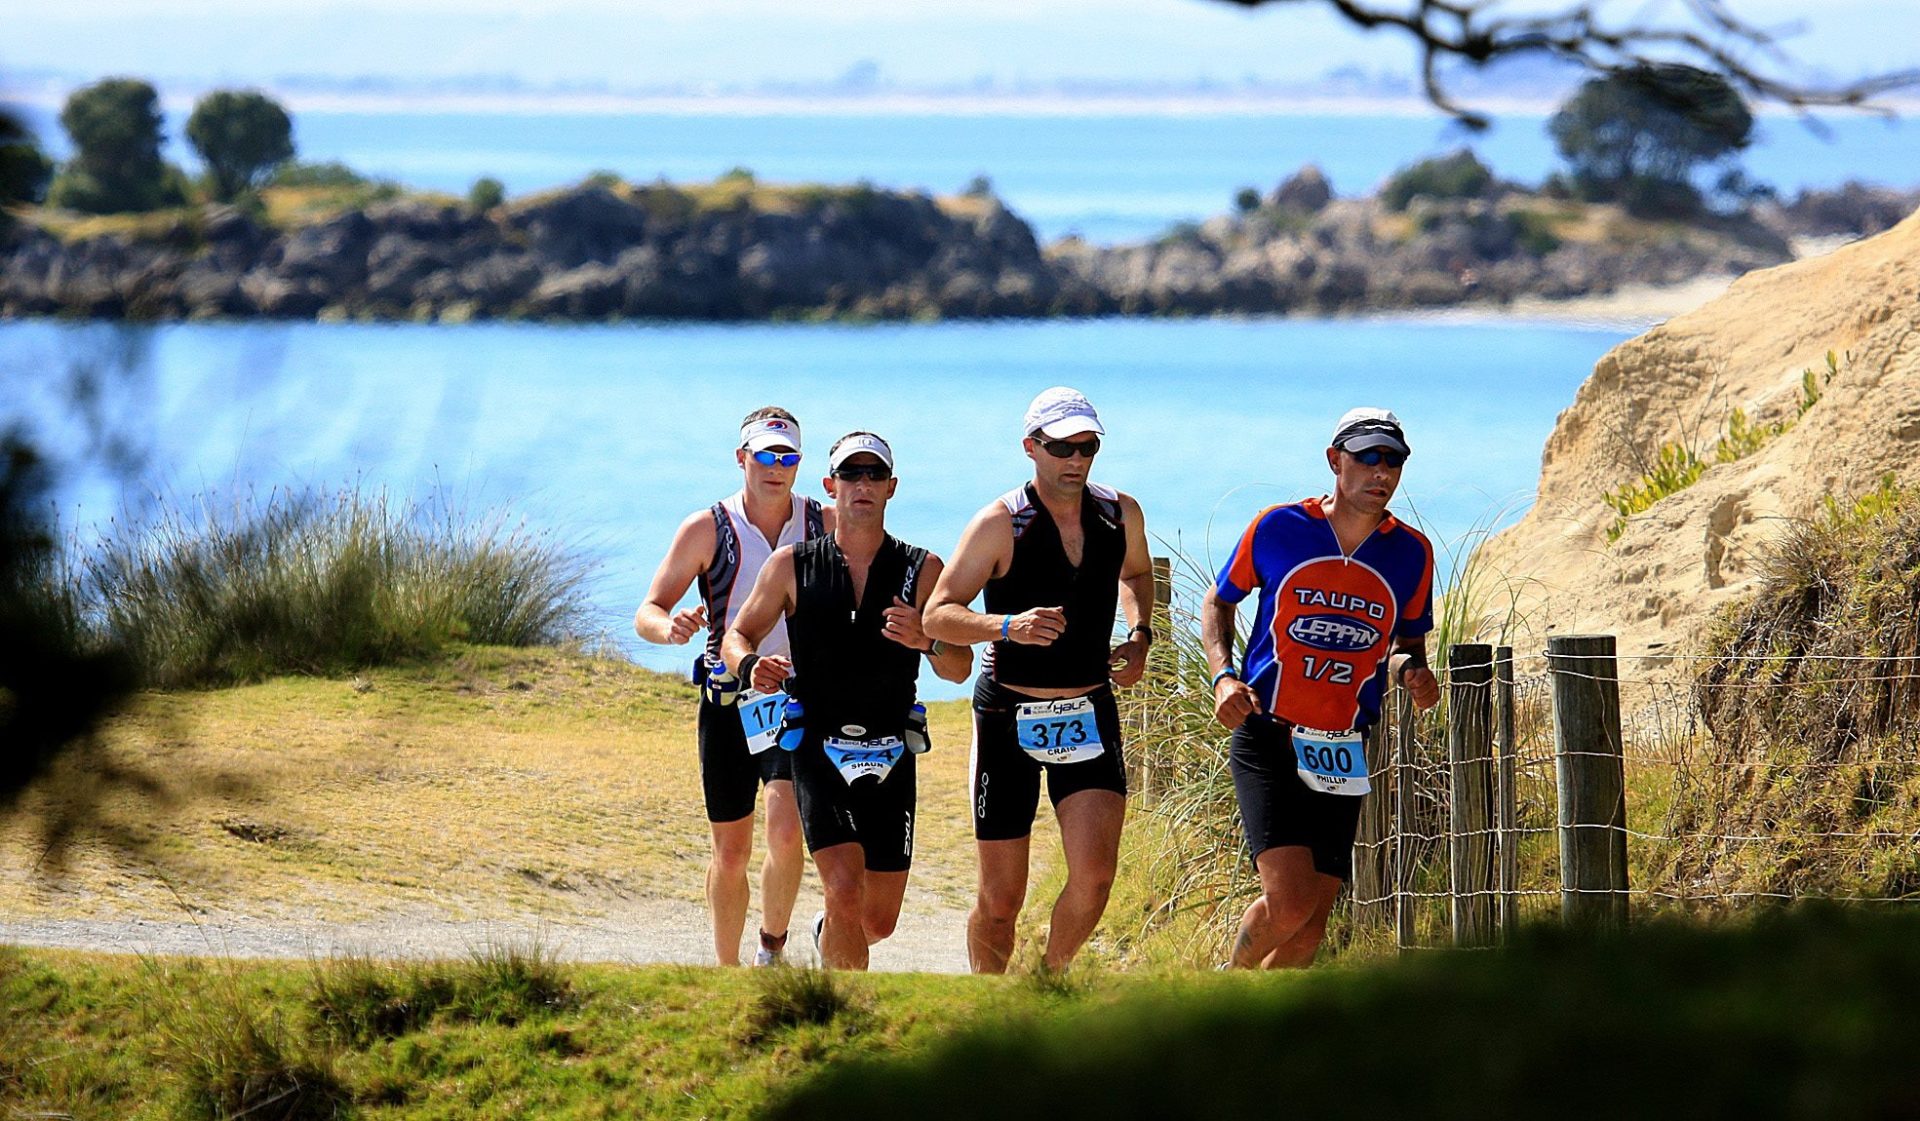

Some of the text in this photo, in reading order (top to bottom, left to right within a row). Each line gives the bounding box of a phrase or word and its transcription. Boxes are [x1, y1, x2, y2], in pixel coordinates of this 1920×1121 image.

[902, 566, 915, 602] 2XU
[1295, 589, 1385, 619] TAUPO
[1304, 657, 1353, 683] 1/2
[1031, 720, 1087, 749] 373
[1047, 746, 1077, 756] CRAIG
[1303, 745, 1352, 773] 600
[851, 761, 884, 769] SHAUN
[1316, 774, 1348, 785] PHILLIP
